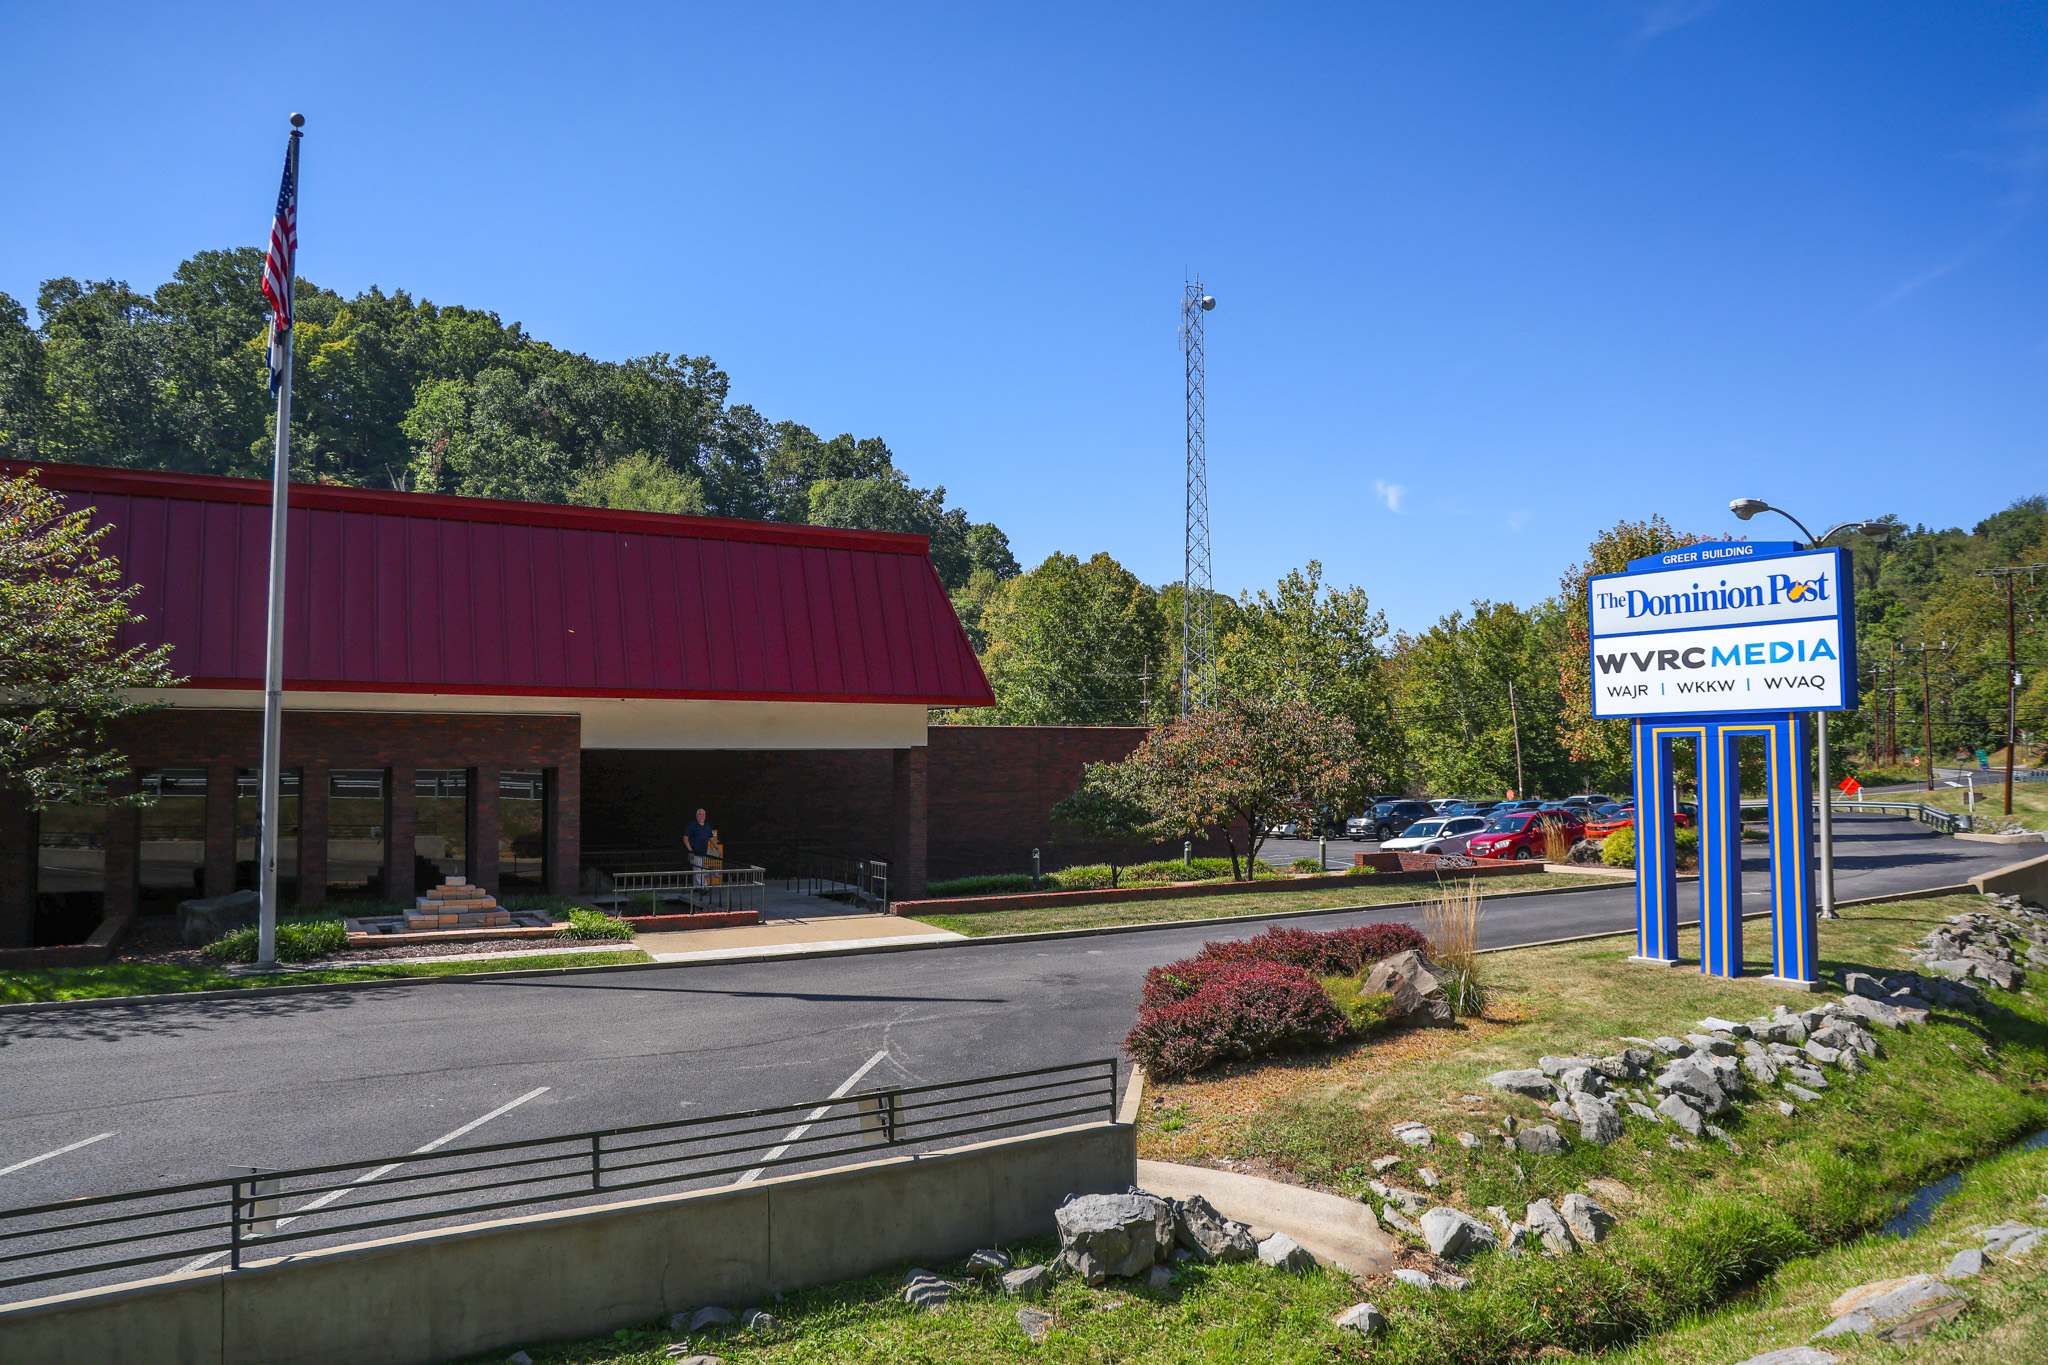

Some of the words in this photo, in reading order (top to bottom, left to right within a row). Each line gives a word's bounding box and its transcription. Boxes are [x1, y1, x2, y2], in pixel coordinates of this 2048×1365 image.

[1662, 551, 1698, 565] GREER
[1701, 545, 1754, 560] BUILDING
[1597, 592, 1626, 610] The
[1626, 580, 1764, 618] Dominion
[1767, 571, 1830, 606] Post
[1607, 684, 1649, 699] WAJR
[1677, 679, 1736, 694] WKKW
[1763, 674, 1825, 690] WVAQ
